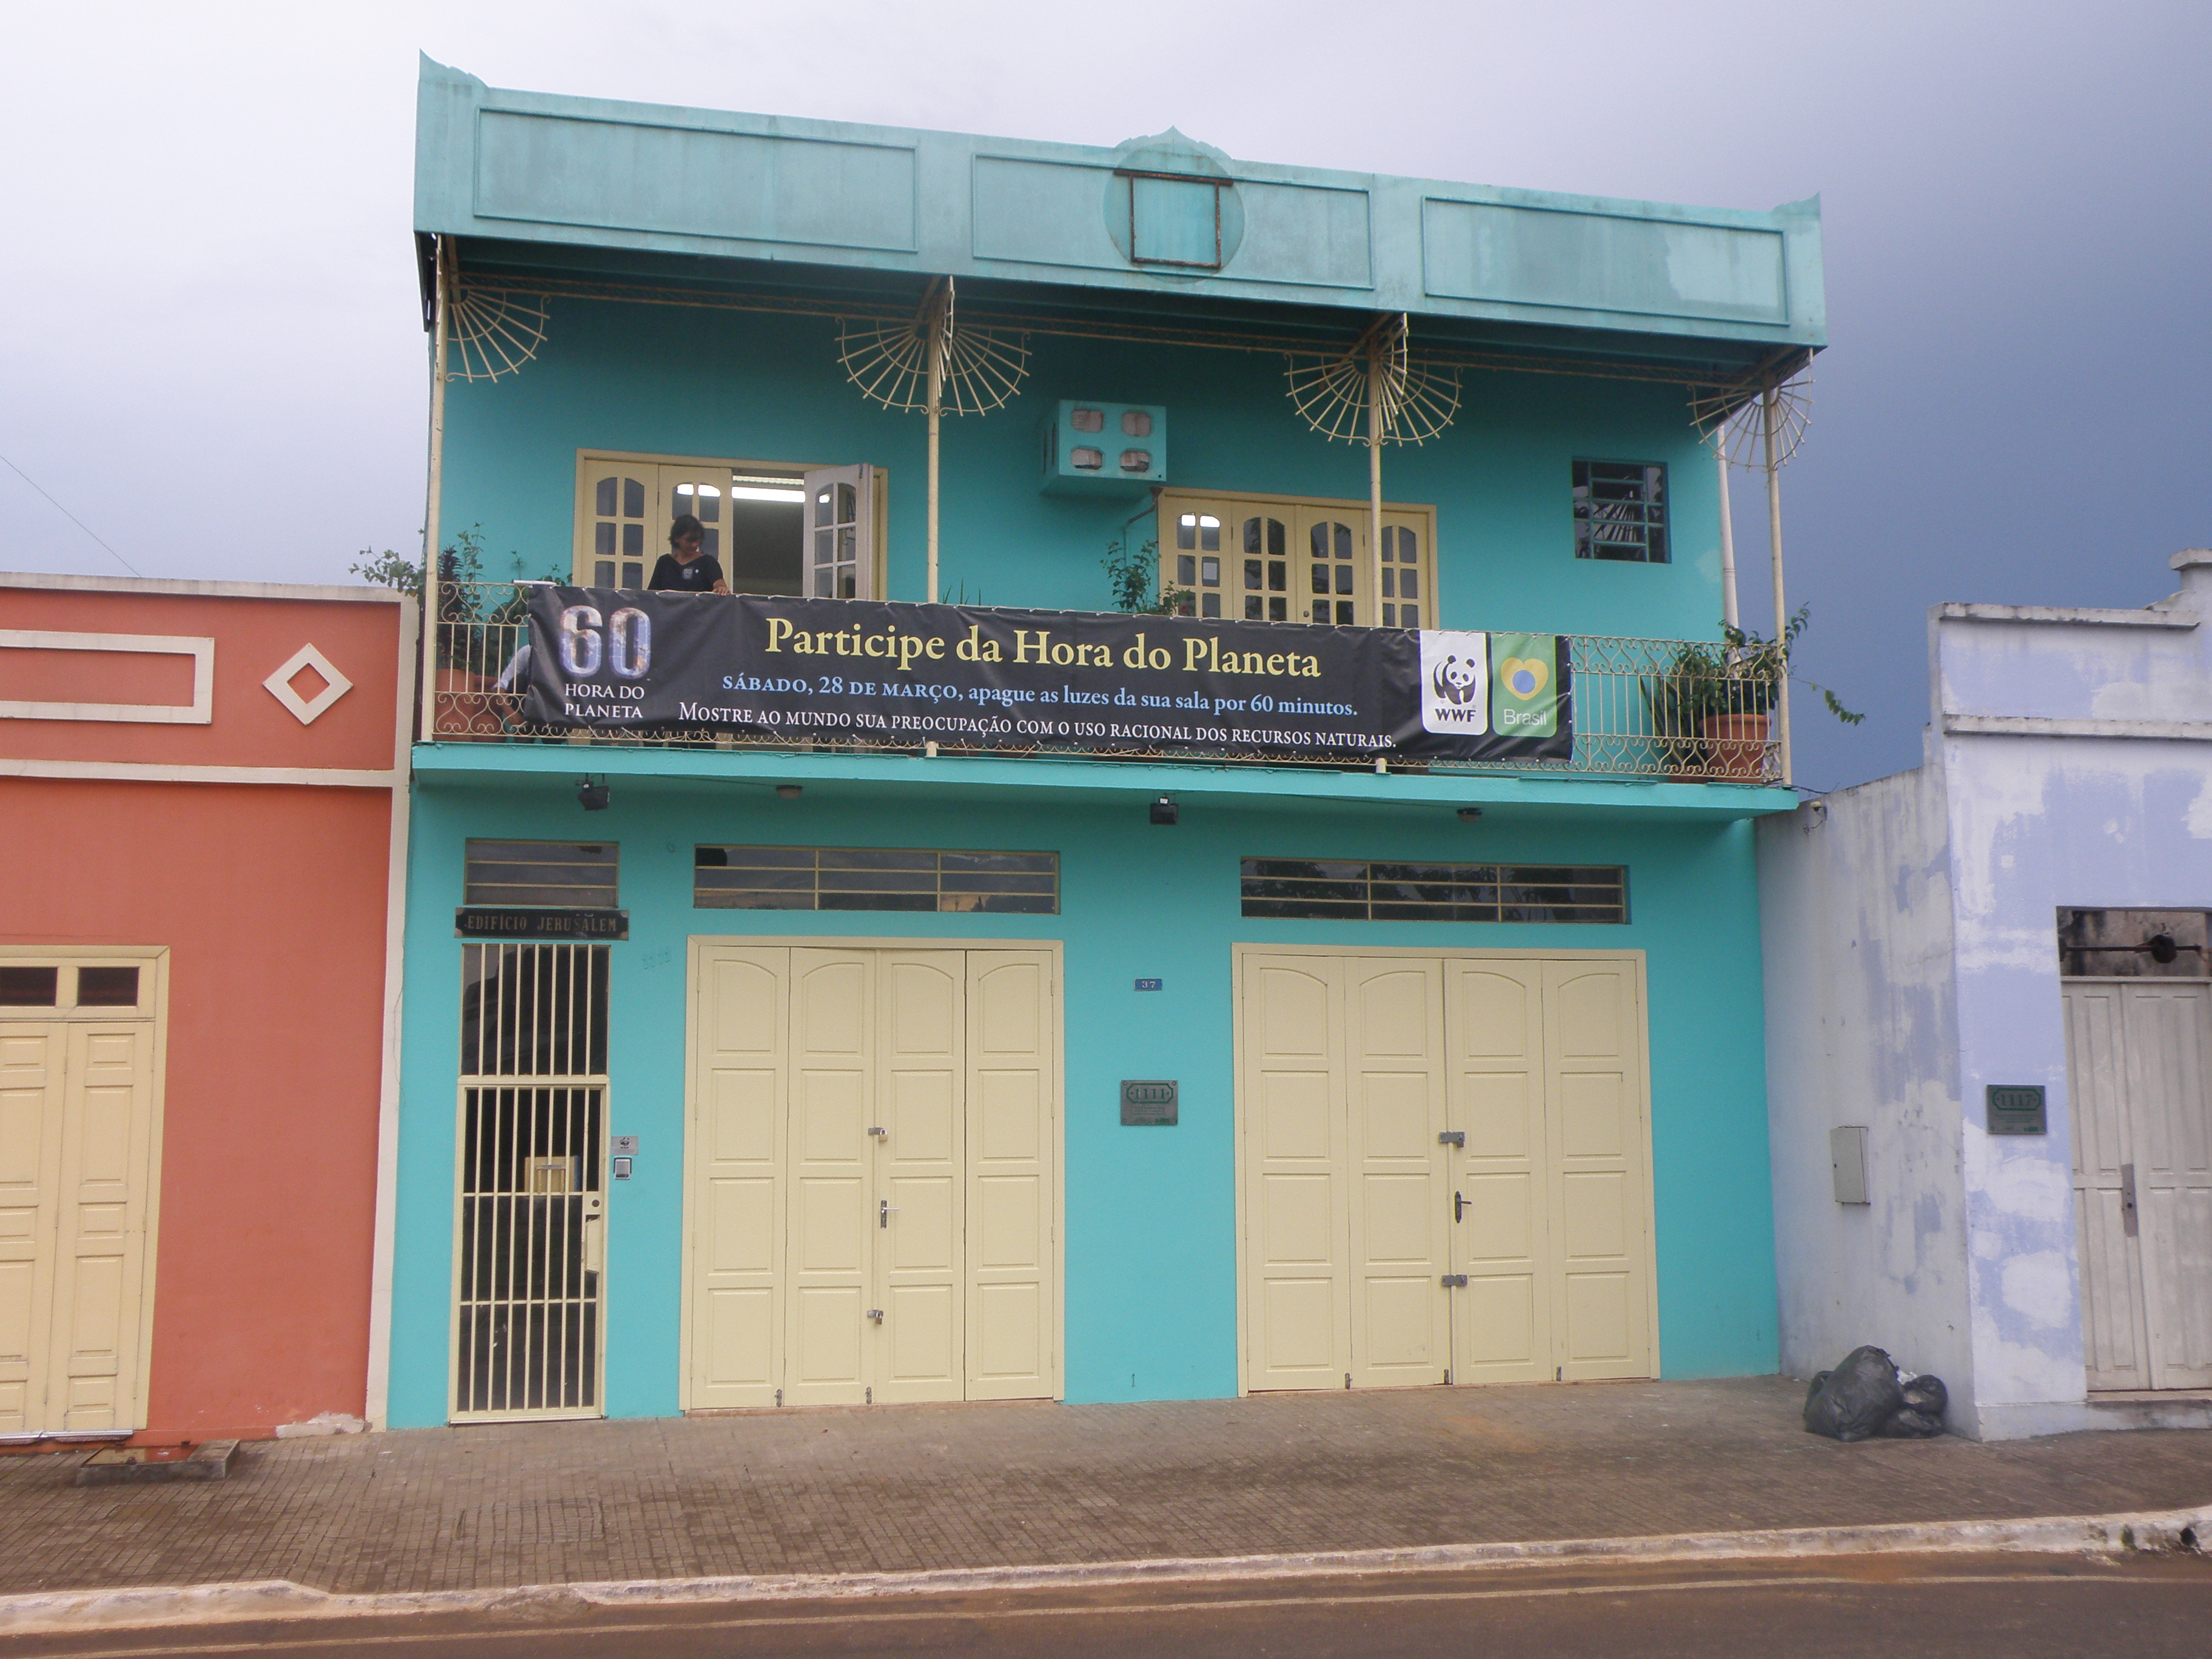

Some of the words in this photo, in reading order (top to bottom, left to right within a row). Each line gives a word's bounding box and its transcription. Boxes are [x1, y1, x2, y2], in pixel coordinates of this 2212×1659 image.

[559, 605, 651, 680] 60
[765, 617, 945, 671] Participe
[956, 625, 1003, 662] da
[1013, 629, 1113, 668] Hora
[1123, 633, 1171, 670] do
[1182, 637, 1321, 678] Planeta
[565, 683, 615, 699] HORA
[619, 686, 645, 700] DO
[722, 672, 814, 695] SÁBADO,
[819, 676, 843, 694] 28
[849, 682, 876, 695] DE
[882, 683, 964, 703] MARÇO,
[968, 686, 1035, 707] apague
[1039, 690, 1059, 703] as
[1062, 685, 1109, 705] luzes
[1114, 687, 1137, 706] da
[1141, 694, 1171, 708] sua
[1175, 691, 1210, 710] sala
[1213, 697, 1247, 716] por
[1250, 694, 1273, 712] 60
[1278, 697, 1358, 716] minutos.
[565, 703, 643, 719] PLANETA
[1435, 708, 1476, 722] WWF
[1503, 708, 1547, 726] Brasil
[678, 702, 753, 723] MOSTRE
[757, 710, 780, 725] AO
[785, 711, 851, 726] MUNDO
[856, 714, 887, 728] SUA
[891, 716, 1011, 738] PREOCUPAÇÃO
[1016, 719, 1054, 735] COM
[1057, 721, 1070, 735] O
[1074, 722, 1105, 737] USO
[1110, 723, 1191, 740] RACIONAL
[1196, 727, 1227, 742] DOS
[1231, 728, 1312, 745] RECURSOS
[1315, 731, 1396, 748] NATURAIS.
[1141, 980, 1156, 988] 37
